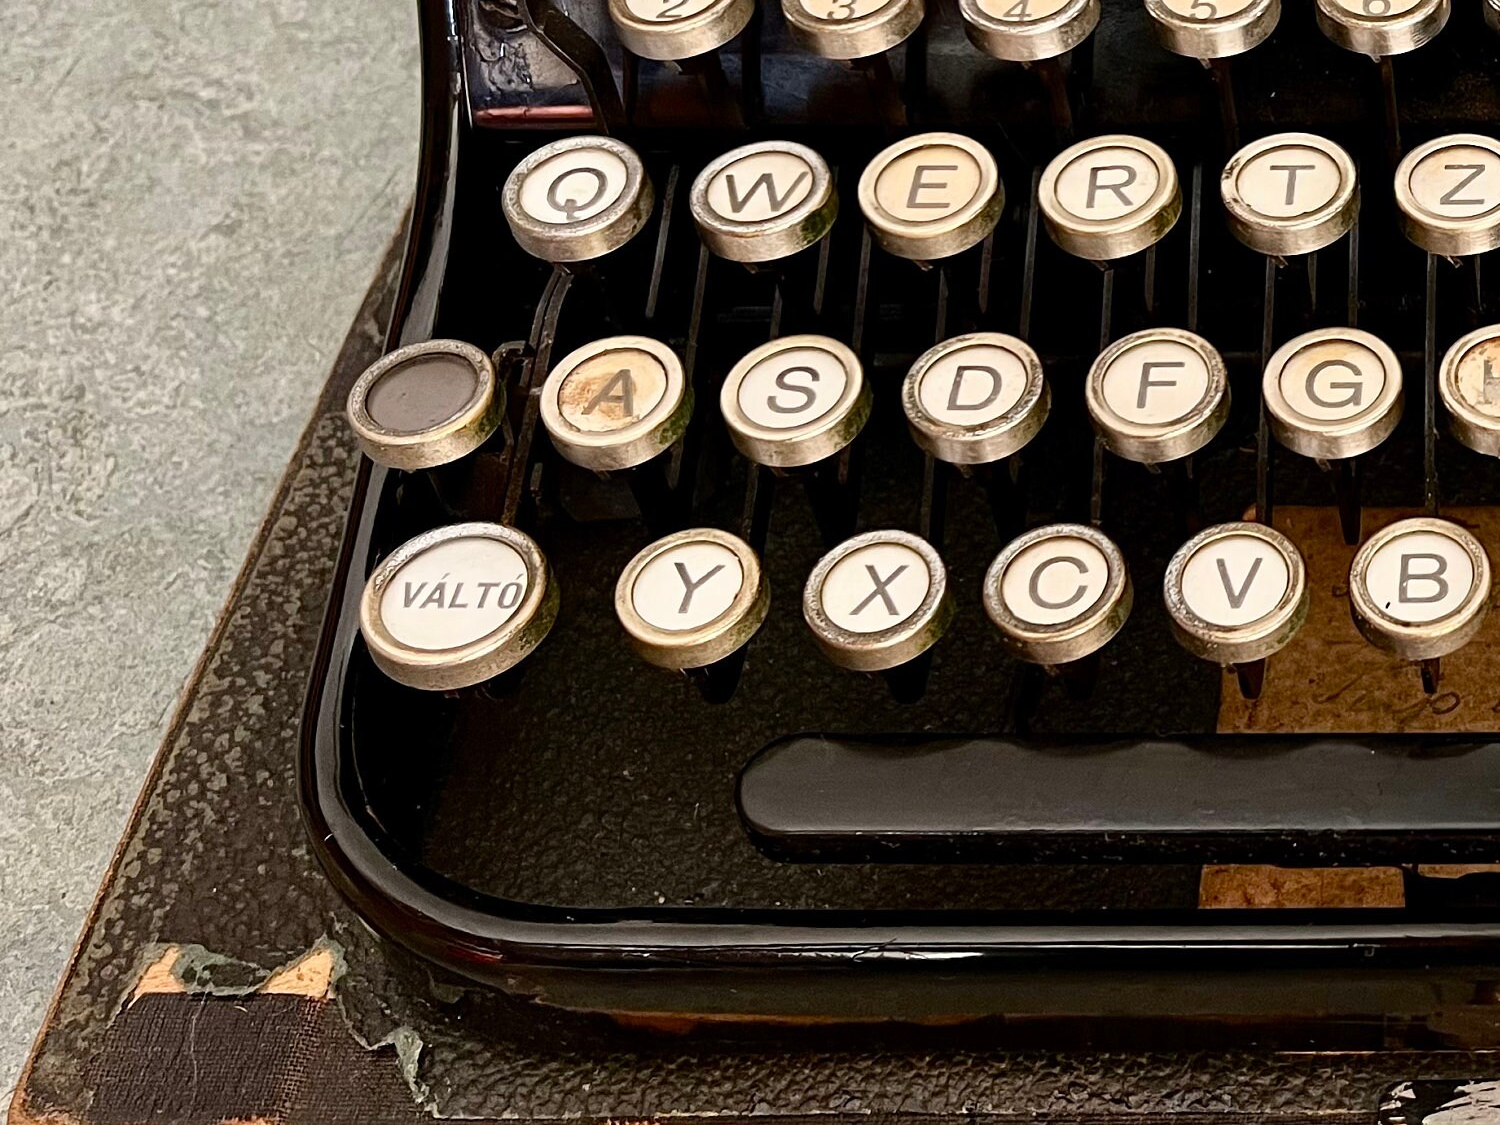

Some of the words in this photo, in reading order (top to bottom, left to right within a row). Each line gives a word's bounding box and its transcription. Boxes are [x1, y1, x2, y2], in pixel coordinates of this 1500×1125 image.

[548, 166, 606, 219] Q
[726, 170, 809, 214] W
[906, 164, 958, 209] E
[1085, 164, 1135, 208] R
[1270, 164, 1315, 205] T
[1440, 164, 1485, 205] Z
[582, 369, 640, 416] A
[766, 366, 820, 414] S
[946, 365, 1001, 411] D
[1136, 361, 1185, 409] F
[1304, 359, 1362, 407] G
[402, 571, 523, 611] VÁLTÓ
[672, 561, 725, 614] Y
[848, 564, 909, 616] X
[1028, 556, 1089, 610] C
[1215, 557, 1263, 609] V
[1398, 553, 1449, 604] B
